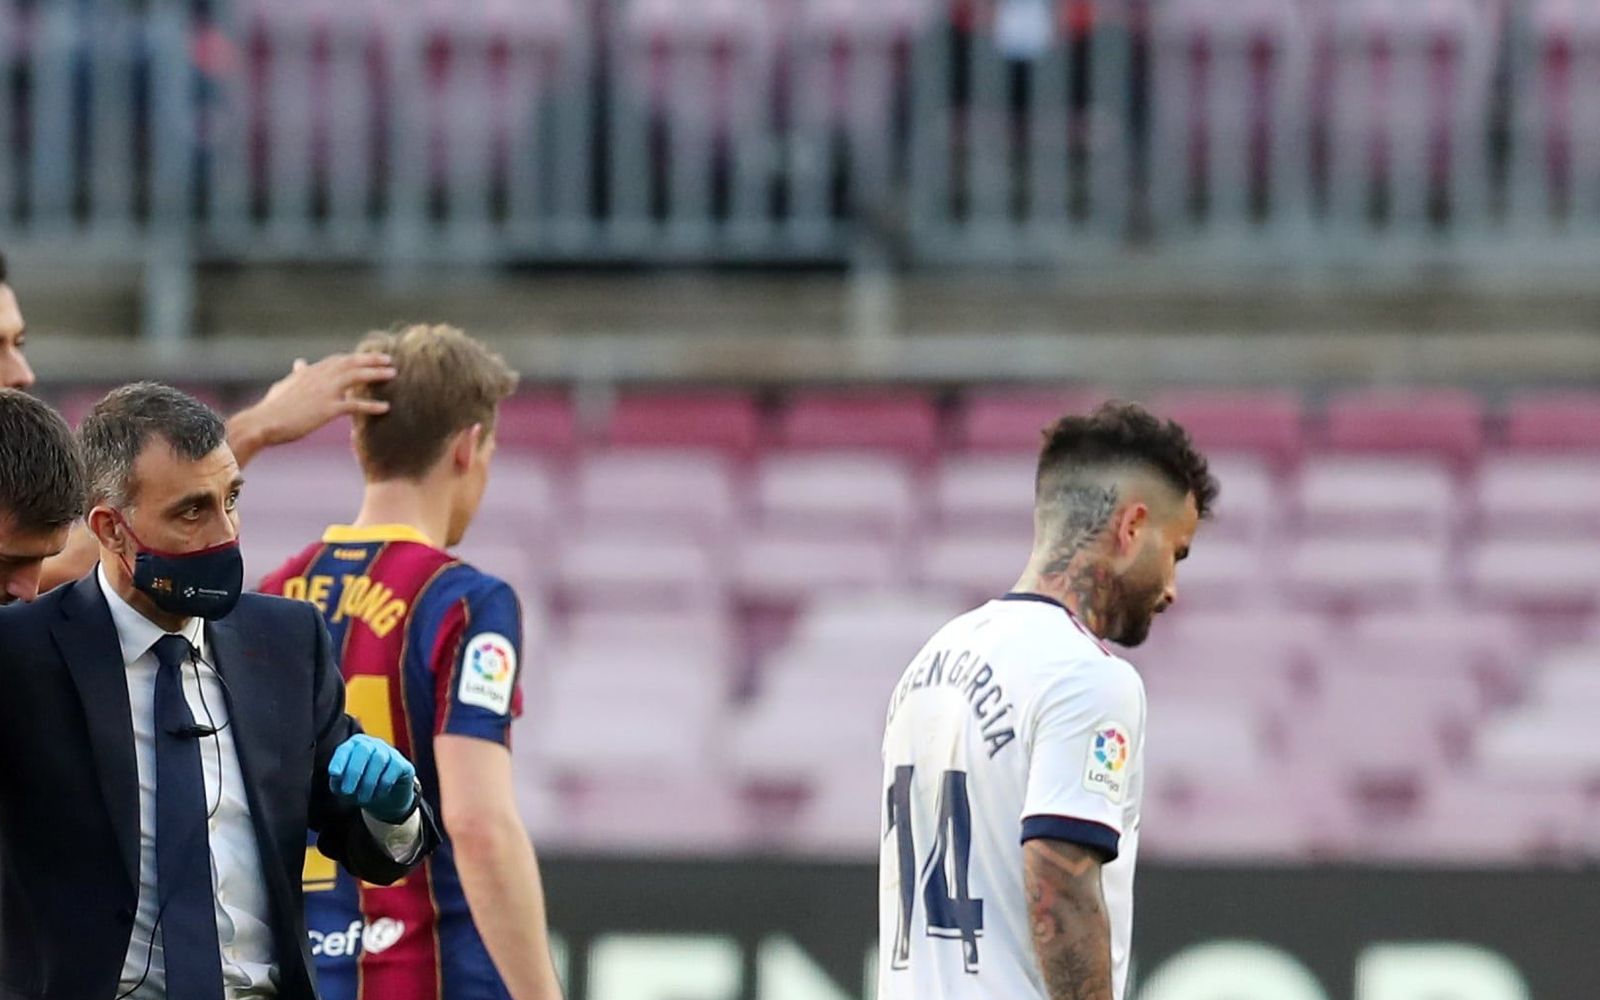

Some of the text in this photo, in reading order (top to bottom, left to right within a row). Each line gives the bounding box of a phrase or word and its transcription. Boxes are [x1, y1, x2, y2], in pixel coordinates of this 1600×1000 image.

[330, 573, 407, 639] JONG
[884, 764, 984, 974] 14
[308, 920, 363, 957] cef
